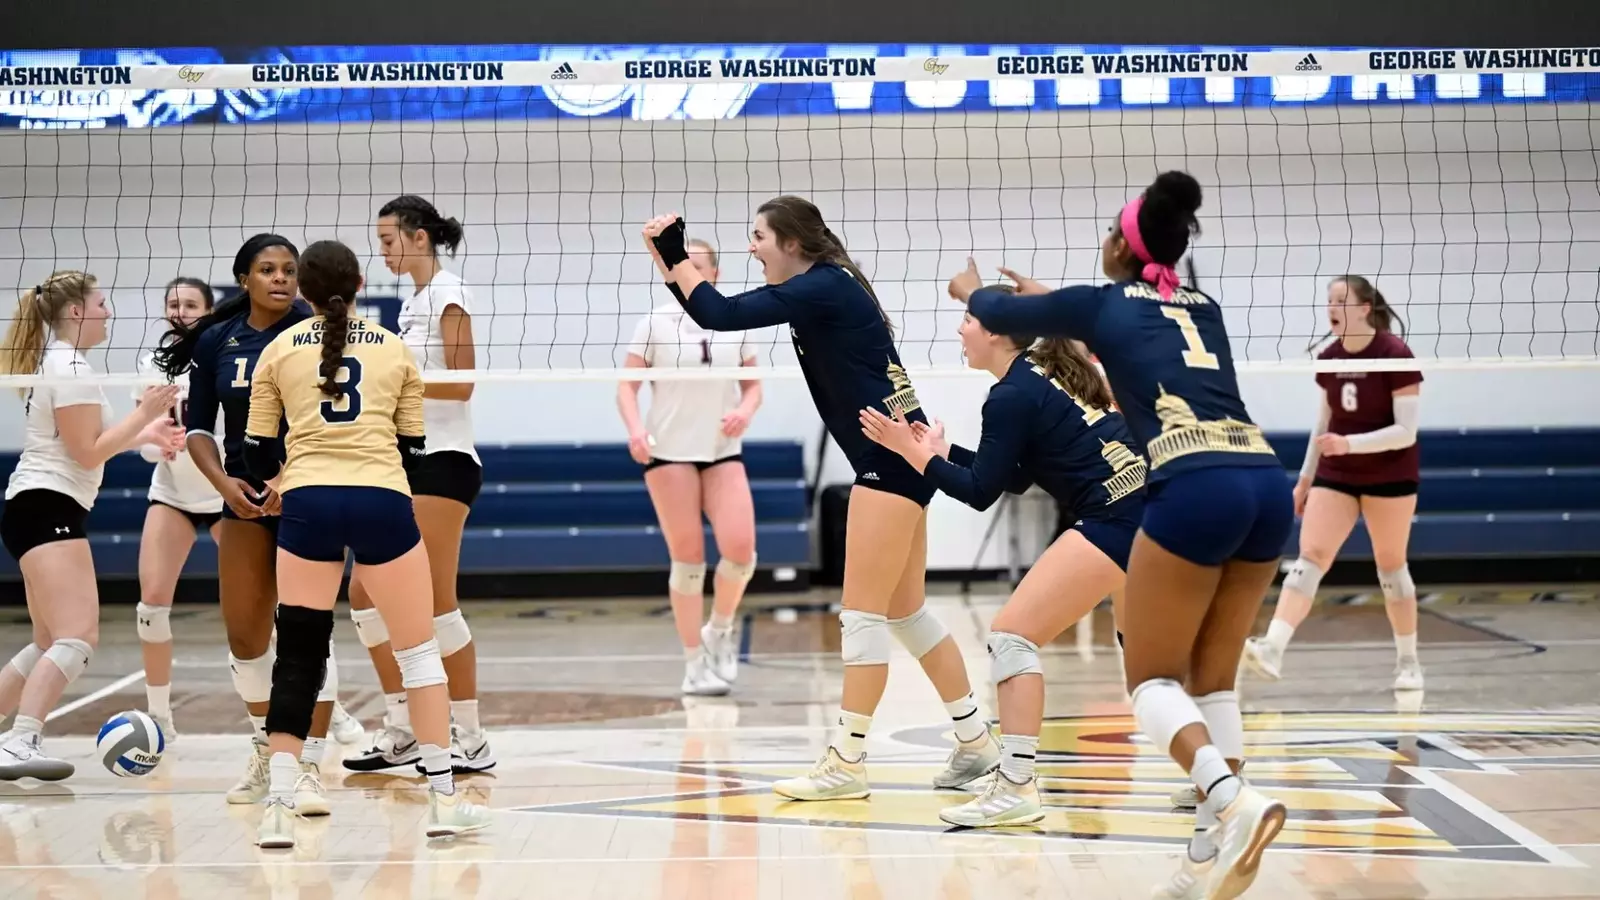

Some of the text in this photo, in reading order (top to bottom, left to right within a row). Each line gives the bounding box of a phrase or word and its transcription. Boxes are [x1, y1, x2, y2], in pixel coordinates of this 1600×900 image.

[625, 58, 876, 79] GEORGE WASHINGTON
[997, 53, 1248, 75] GEORGE WASHINGTON
[1369, 50, 1456, 70] GEORGE
[0, 66, 131, 86] ASHINGTON
[252, 62, 504, 82] GEORGE WASHINGTON
[311, 320, 366, 331] GEGE
[292, 331, 385, 347] WASGTON
[1160, 305, 1220, 370] 1
[700, 338, 711, 364] 1
[318, 355, 363, 425] 3
[1341, 382, 1358, 412] 6
